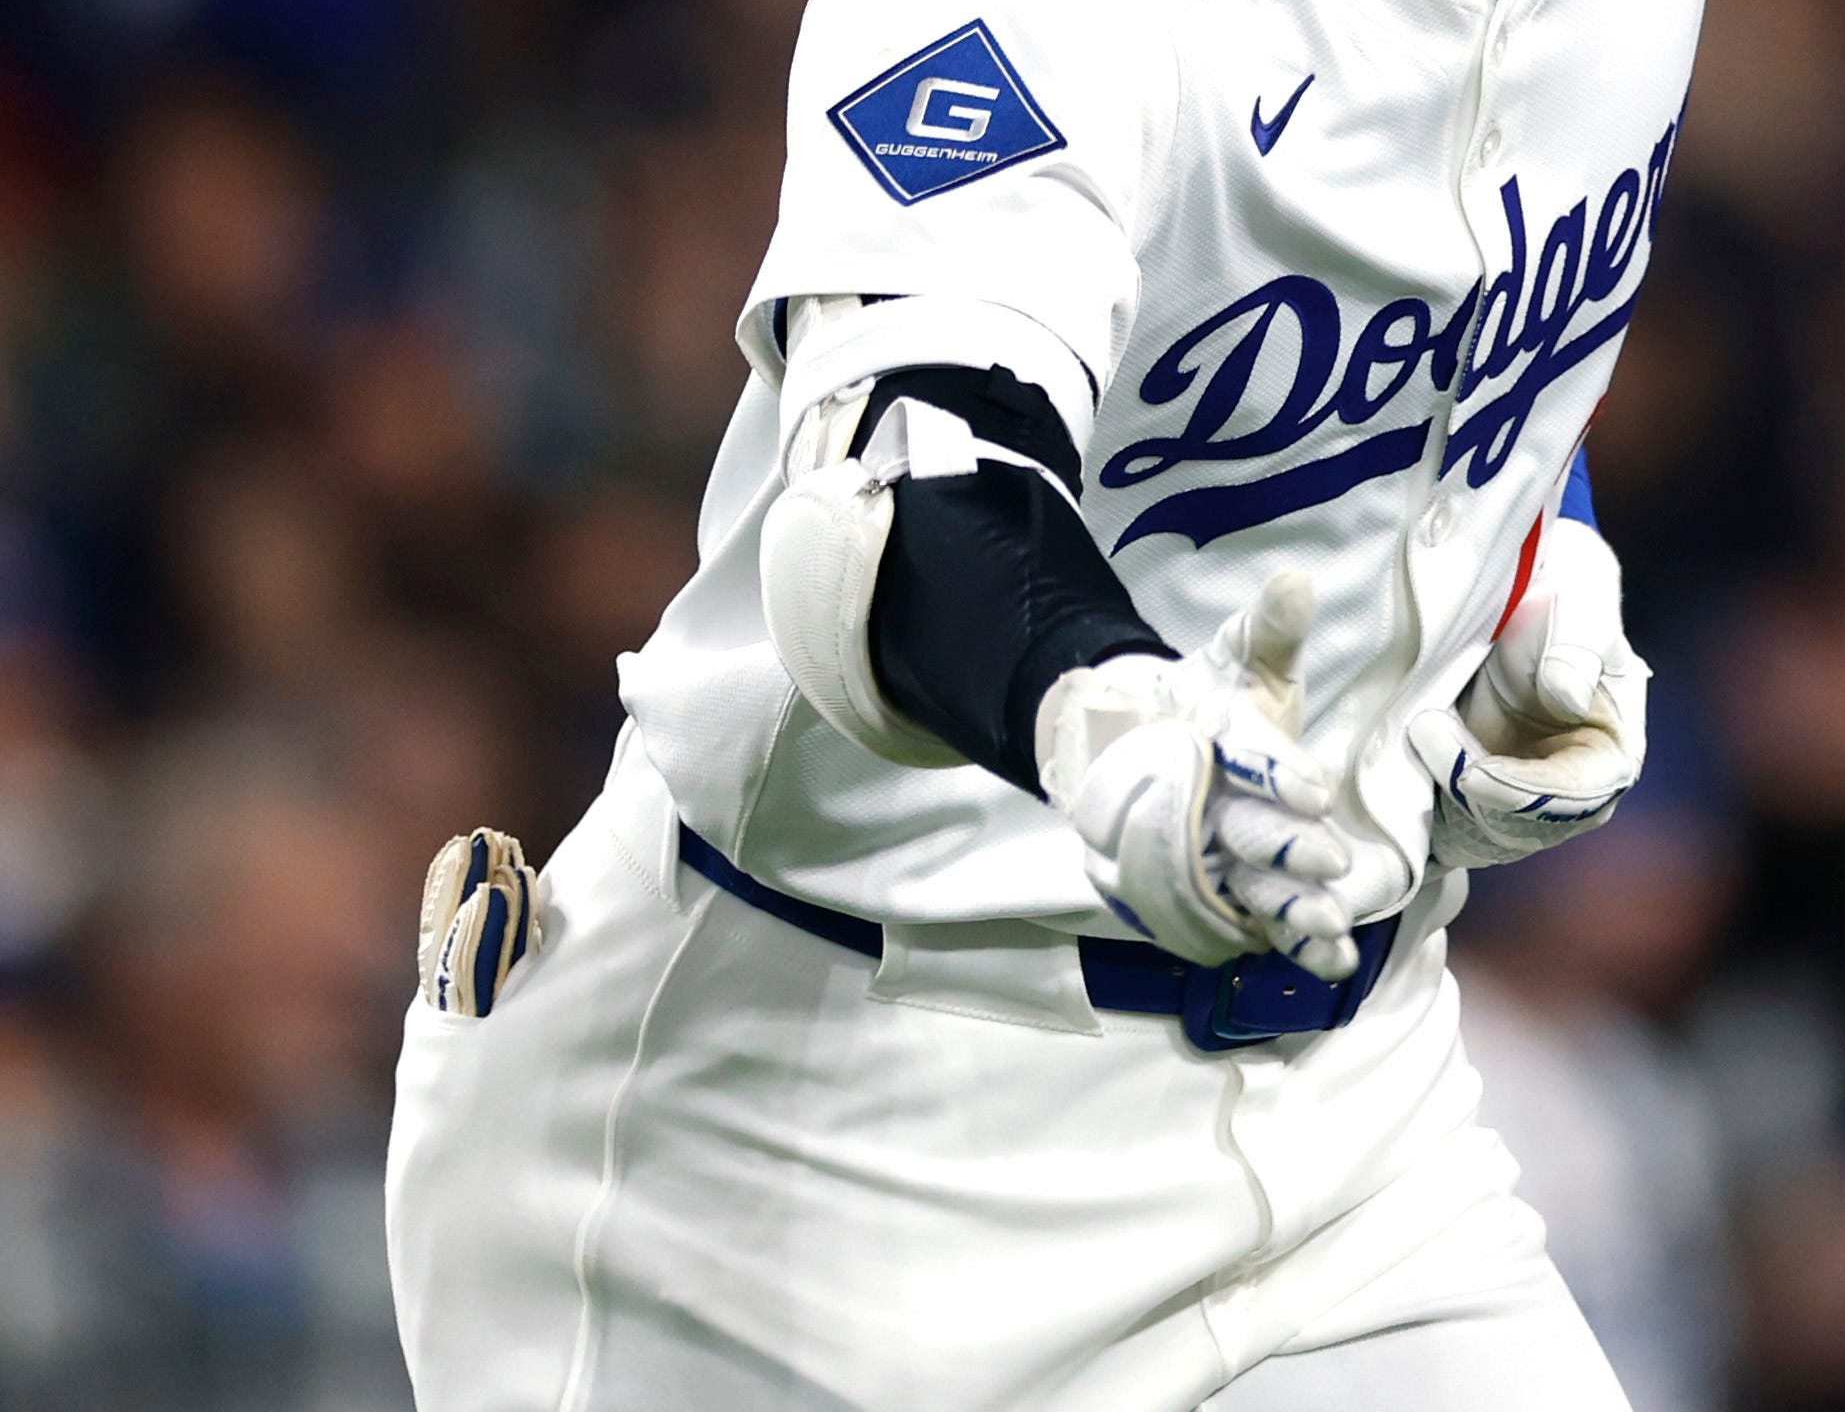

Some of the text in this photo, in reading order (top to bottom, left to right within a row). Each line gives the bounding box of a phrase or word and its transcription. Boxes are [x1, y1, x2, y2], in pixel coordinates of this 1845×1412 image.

[904, 76, 1000, 142] G
[875, 142, 998, 163] GUGGENHEIM
[1100, 118, 1682, 490] Dodger
